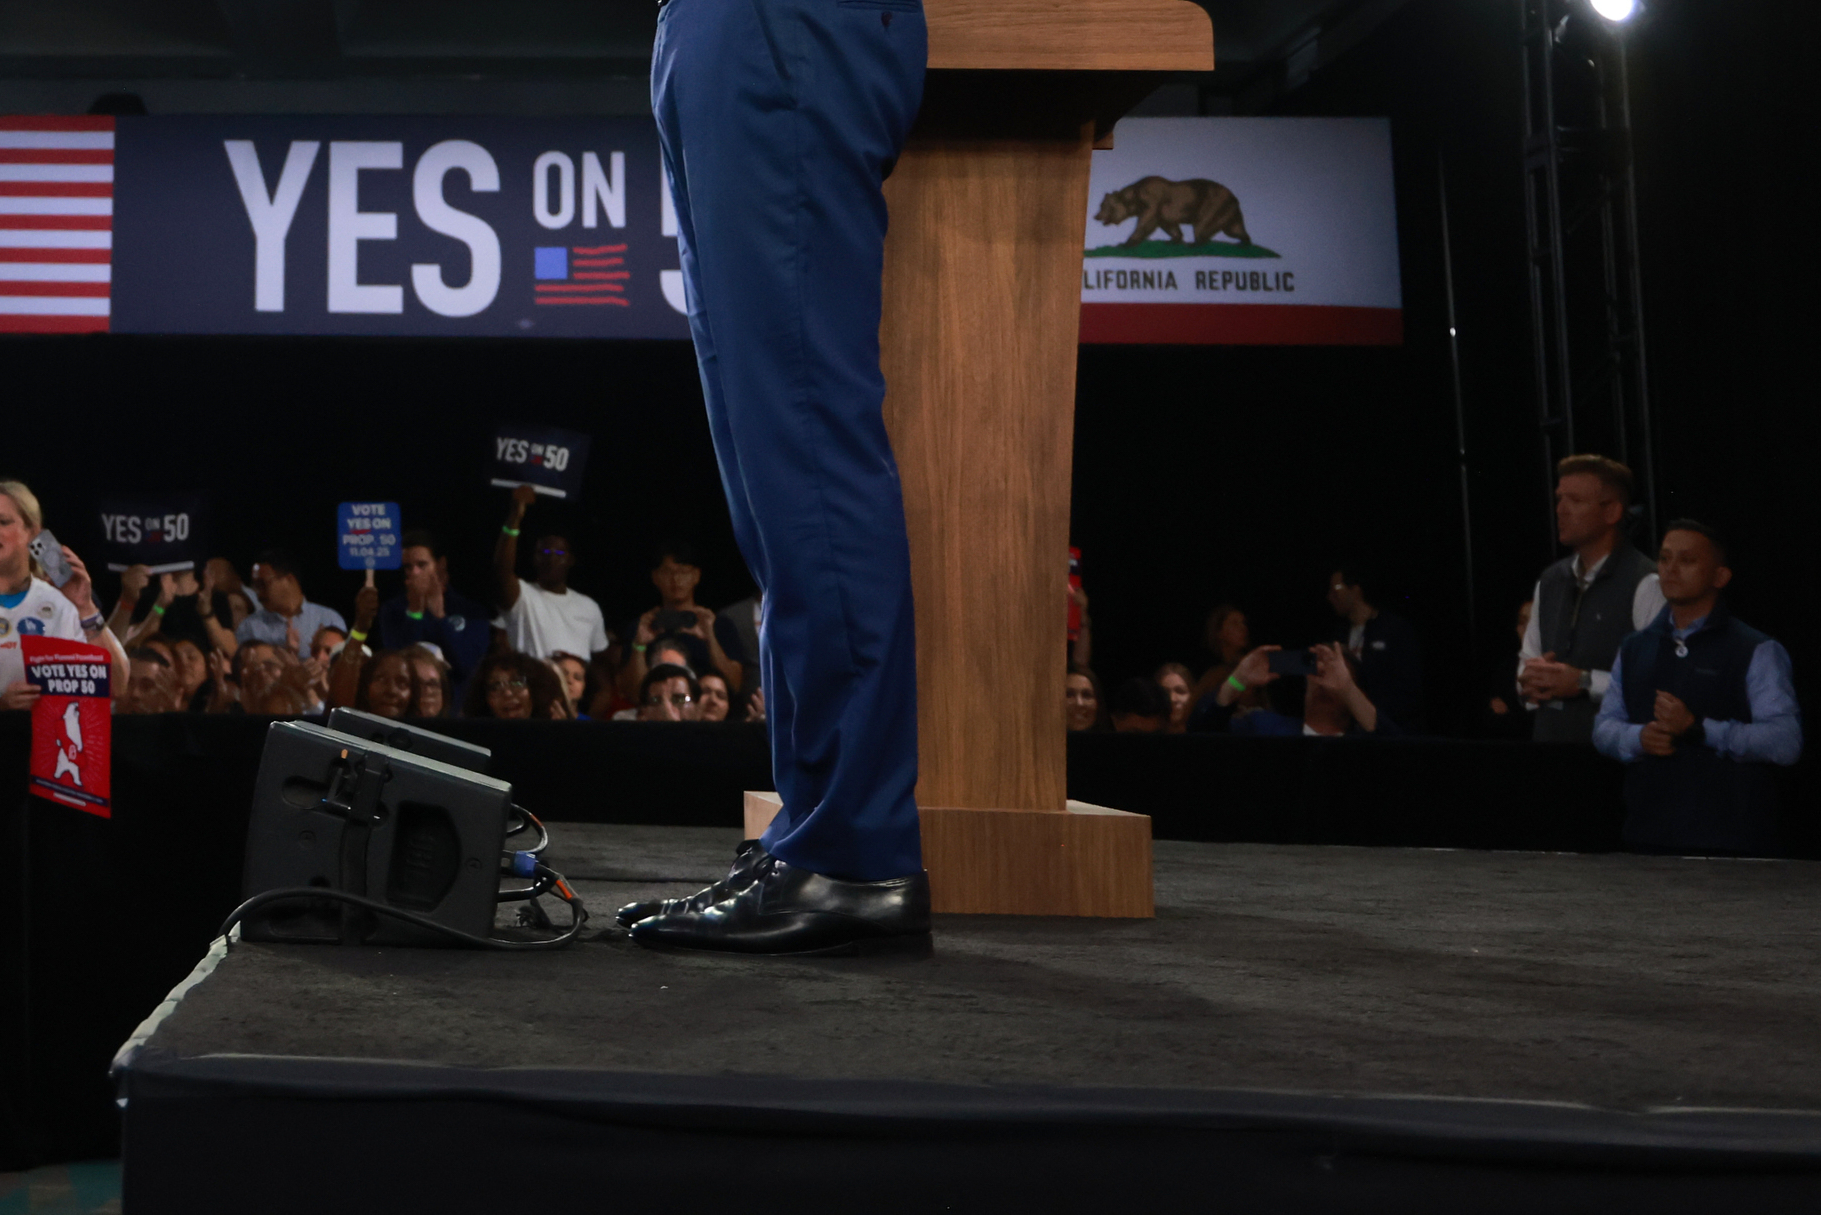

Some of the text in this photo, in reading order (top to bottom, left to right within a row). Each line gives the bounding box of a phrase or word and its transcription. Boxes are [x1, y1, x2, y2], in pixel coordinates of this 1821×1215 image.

[224, 139, 625, 317] YES ON
[1083, 269, 1295, 293] LIFORNIA REPUBLIC
[497, 437, 529, 463] YES
[543, 444, 569, 472] 50
[352, 504, 385, 516] VOTE
[101, 513, 142, 544] YES
[163, 512, 189, 542] 50
[347, 517, 392, 530] YES ON
[31, 664, 107, 679] VOTE YES ON
[47, 679, 96, 694] PROP 50
